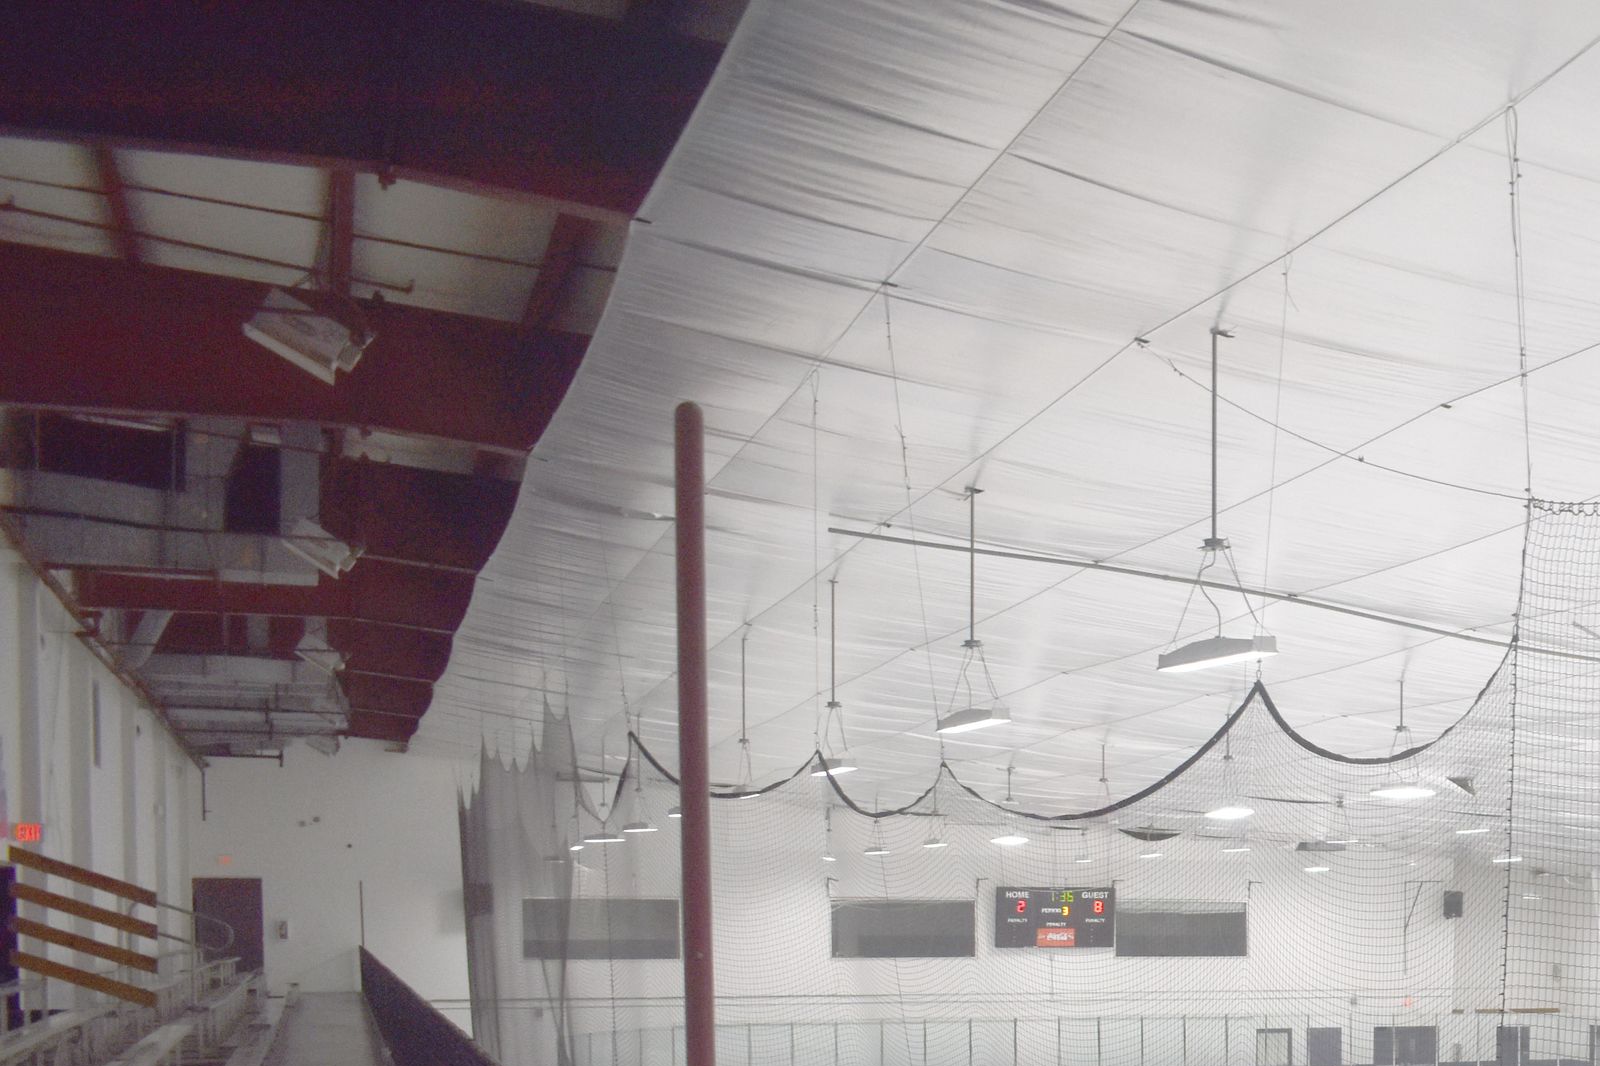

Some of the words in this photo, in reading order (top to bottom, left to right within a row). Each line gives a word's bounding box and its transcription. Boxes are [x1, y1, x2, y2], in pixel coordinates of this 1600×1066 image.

[16, 822, 42, 842] EXIT
[1005, 890, 1030, 899] HOME
[1081, 891, 1109, 899] GUEST
[1016, 899, 1027, 913] 2
[1061, 905, 1070, 916] 3
[1093, 900, 1104, 913] 8
